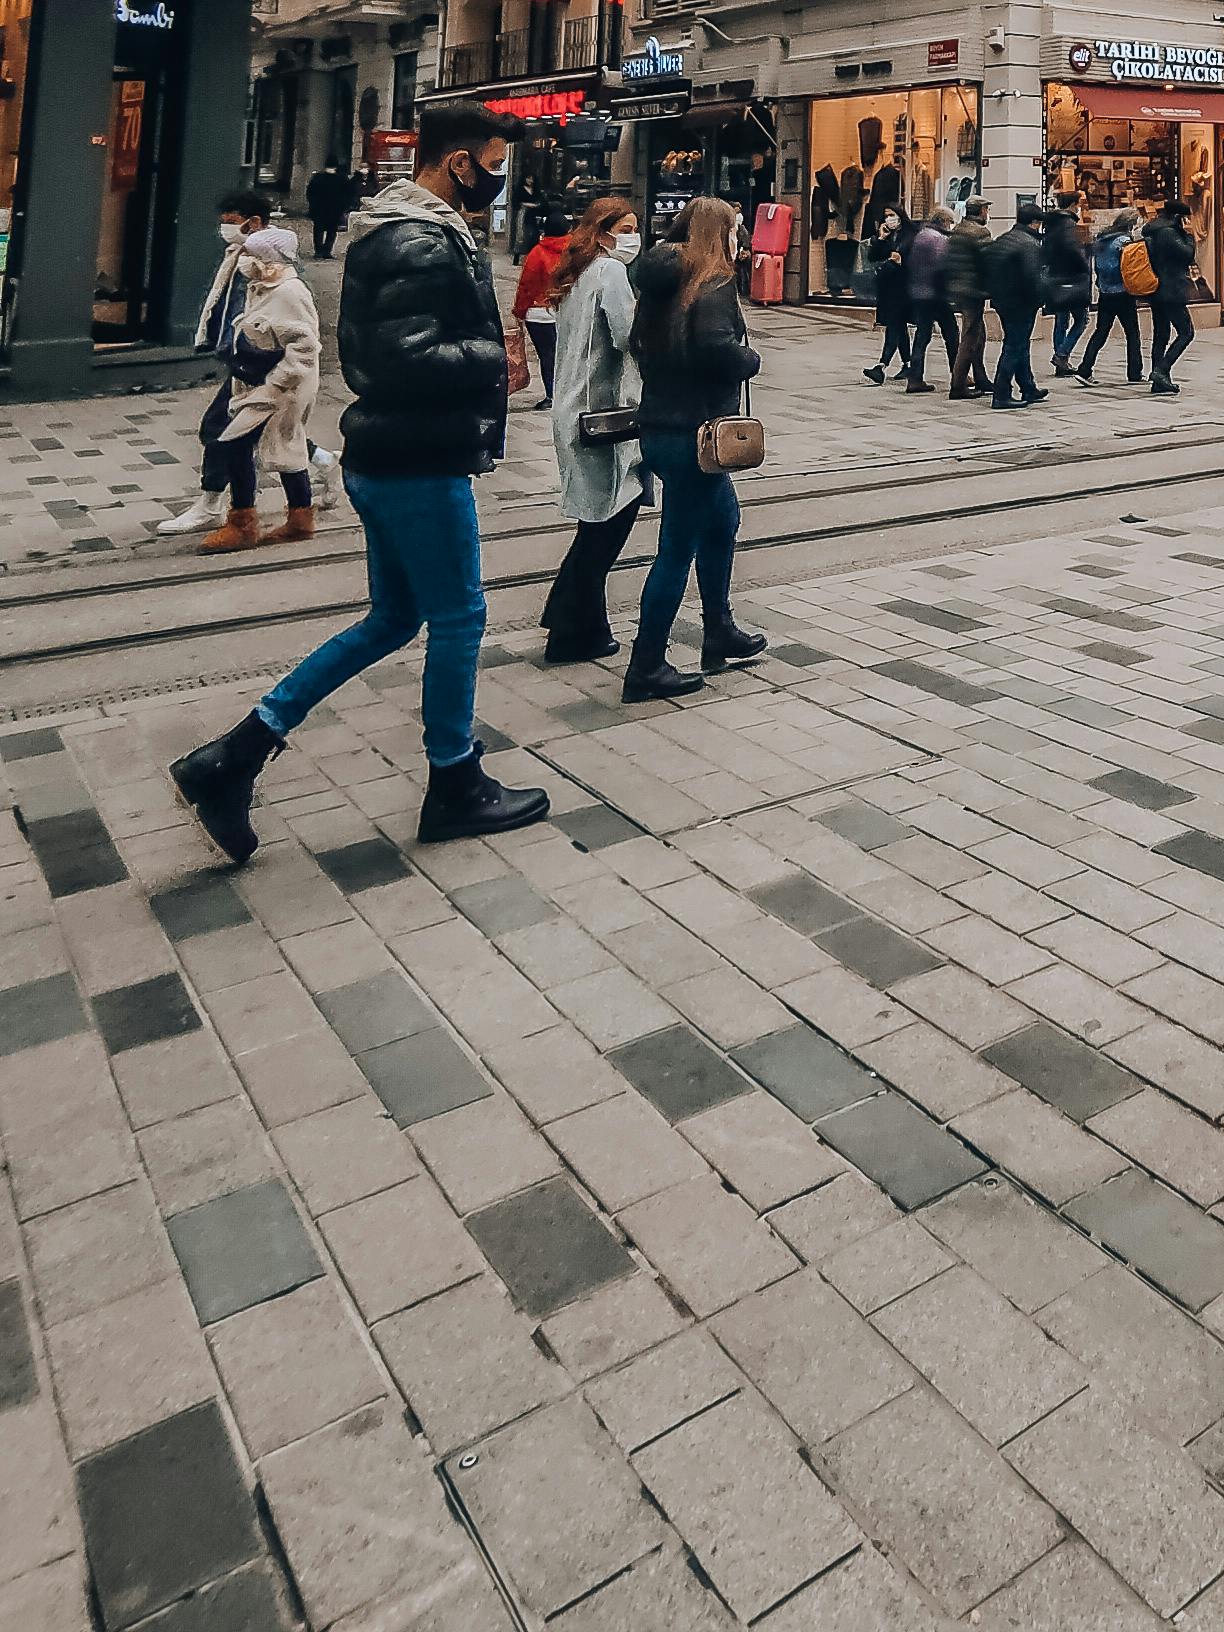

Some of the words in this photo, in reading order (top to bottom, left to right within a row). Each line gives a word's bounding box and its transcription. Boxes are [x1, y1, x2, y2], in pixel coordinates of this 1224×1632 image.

[1073, 48, 1090, 62] elit
[1095, 40, 1161, 61] TARİHİ
[1111, 57, 1224, 84] ÇİKOLATACISI
